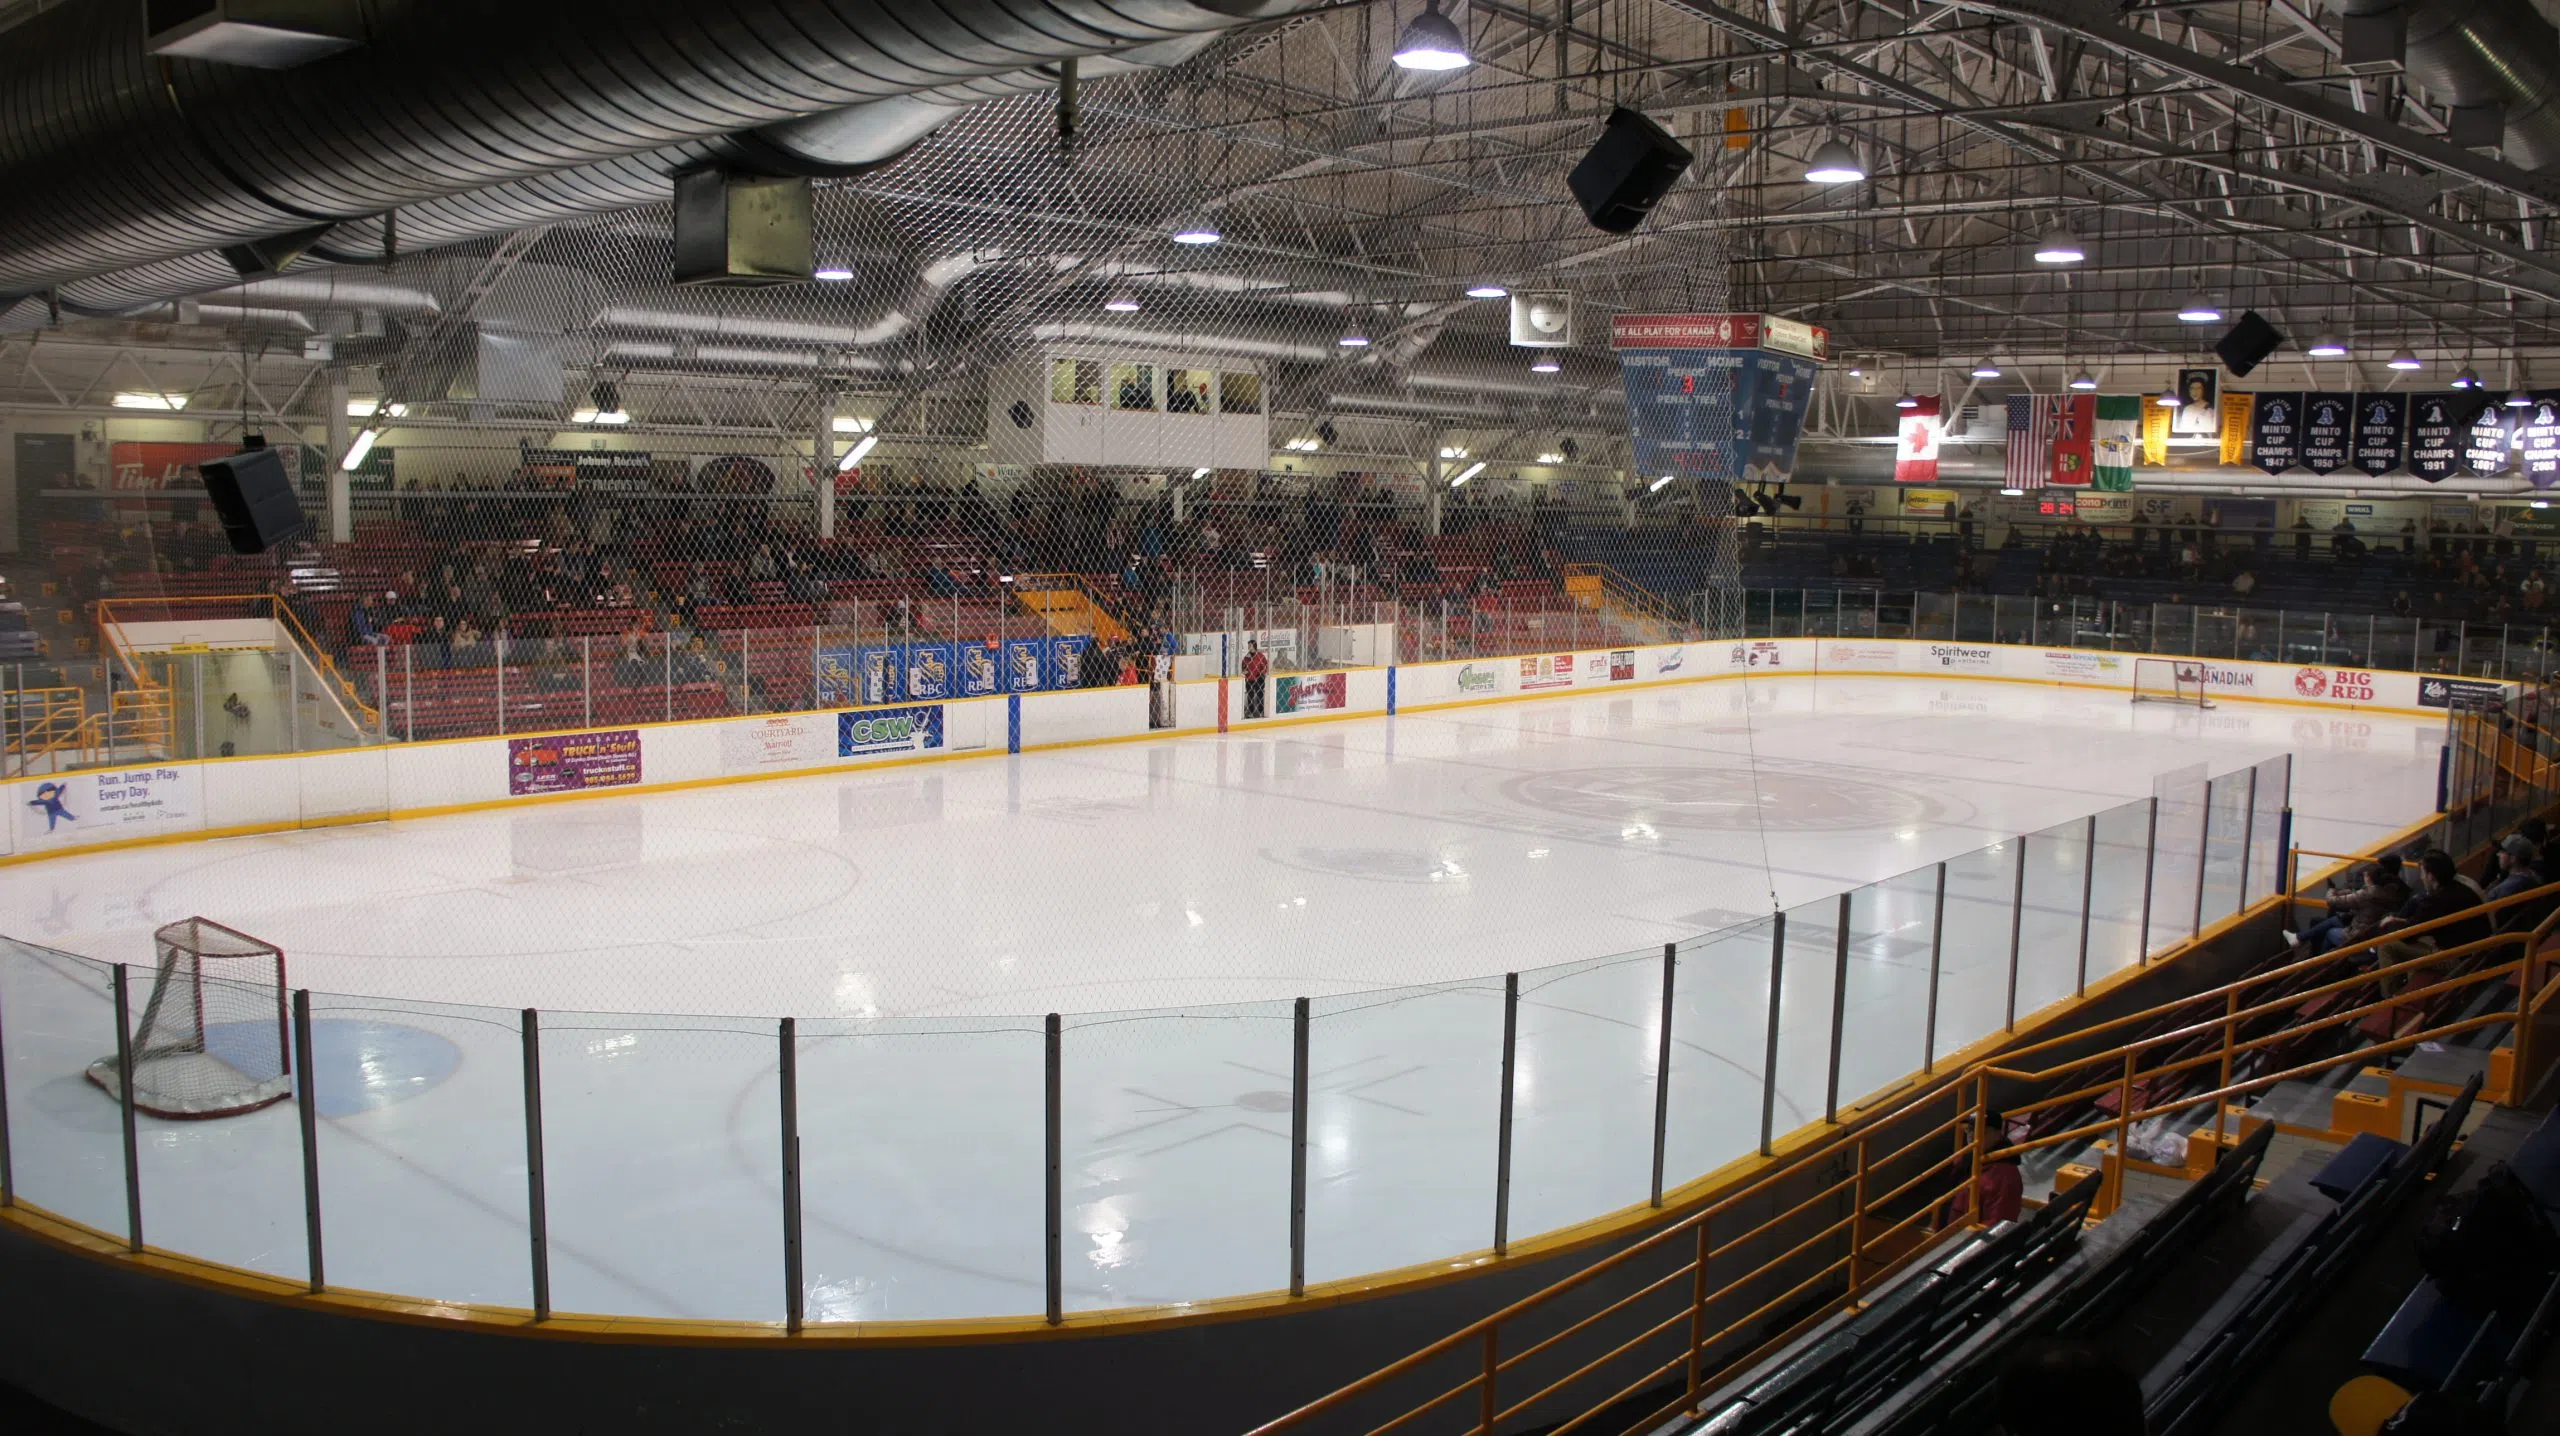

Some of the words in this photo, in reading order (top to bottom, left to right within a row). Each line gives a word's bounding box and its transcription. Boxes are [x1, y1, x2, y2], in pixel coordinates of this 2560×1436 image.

[1614, 327, 1625, 336] WE
[1627, 327, 1642, 336] ALL
[1643, 327, 1663, 336] PLAY
[1664, 327, 1681, 336] FOR
[1682, 326, 1715, 336] CANADA
[1622, 356, 1671, 366] VISITOR
[1707, 356, 1744, 367] HOME
[1736, 430, 1744, 439] 2
[2262, 425, 2291, 434] MINTO
[2310, 427, 2341, 435] MINTO
[2363, 426, 2394, 435] MINTO
[2418, 427, 2451, 436] MINTO
[2471, 427, 2505, 438] MINTO
[2527, 426, 2560, 438] MINTO
[2266, 436, 2285, 444] CUP
[2315, 438, 2334, 446] CUP
[2368, 437, 2387, 446] CUP
[2424, 438, 2444, 447] CUP
[2475, 438, 2497, 448] CUP
[2533, 437, 2556, 448] CUP
[2257, 447, 2293, 456] CHAMPS
[2306, 448, 2342, 457] CHAMPS
[2358, 448, 2395, 458] CHAMPS
[2413, 449, 2455, 458] CHAMPS
[2466, 449, 2505, 462] CHAMPS
[2524, 449, 2560, 460] CHAMPS
[2265, 458, 2284, 466] 1947
[2313, 459, 2333, 467] 1950
[2423, 461, 2445, 470] 1991
[2041, 502, 2054, 514] 28
[2060, 502, 2074, 514] 24
[1931, 645, 1991, 659] Spiritwear
[2336, 671, 2371, 685] BIG
[919, 684, 943, 695] RBC
[2331, 685, 2374, 700] RED
[751, 727, 804, 739] COURTYARD
[852, 716, 913, 743] CSW
[563, 746, 597, 757] TRUCK
[99, 775, 121, 786] Run.
[123, 772, 152, 784] Jump.
[156, 769, 179, 781] Play.
[100, 788, 126, 800] Every
[129, 786, 150, 798] Day.
